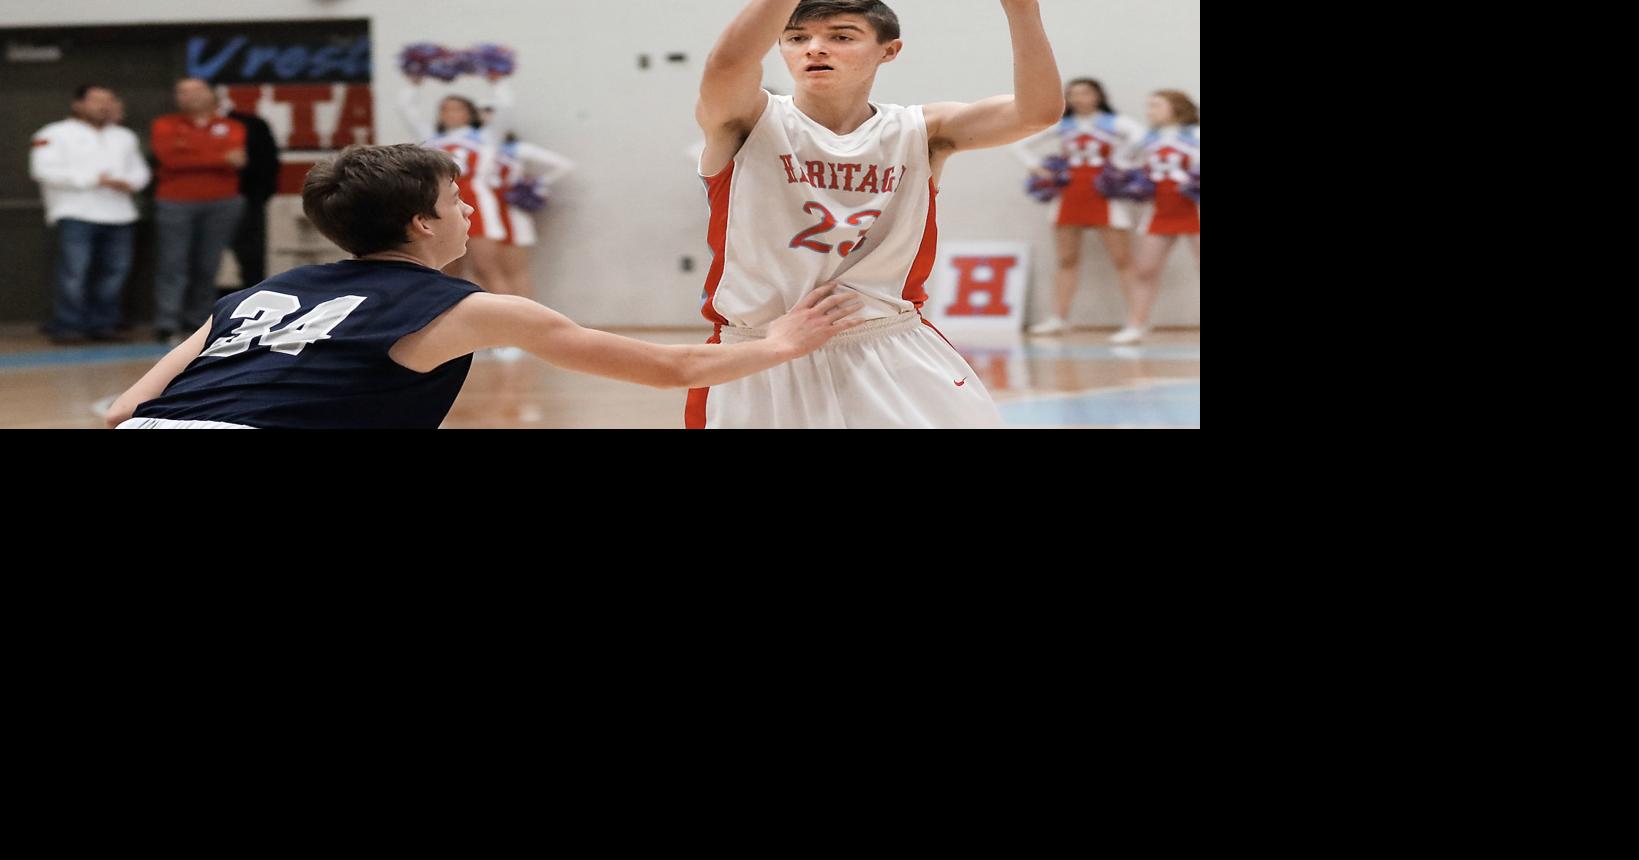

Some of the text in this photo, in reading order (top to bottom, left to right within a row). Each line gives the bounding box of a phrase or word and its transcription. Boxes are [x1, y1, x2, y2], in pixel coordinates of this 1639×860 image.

[779, 153, 907, 194] HRITAG
[788, 200, 882, 257] 23
[944, 256, 1018, 317] H
[199, 290, 368, 357] 34
